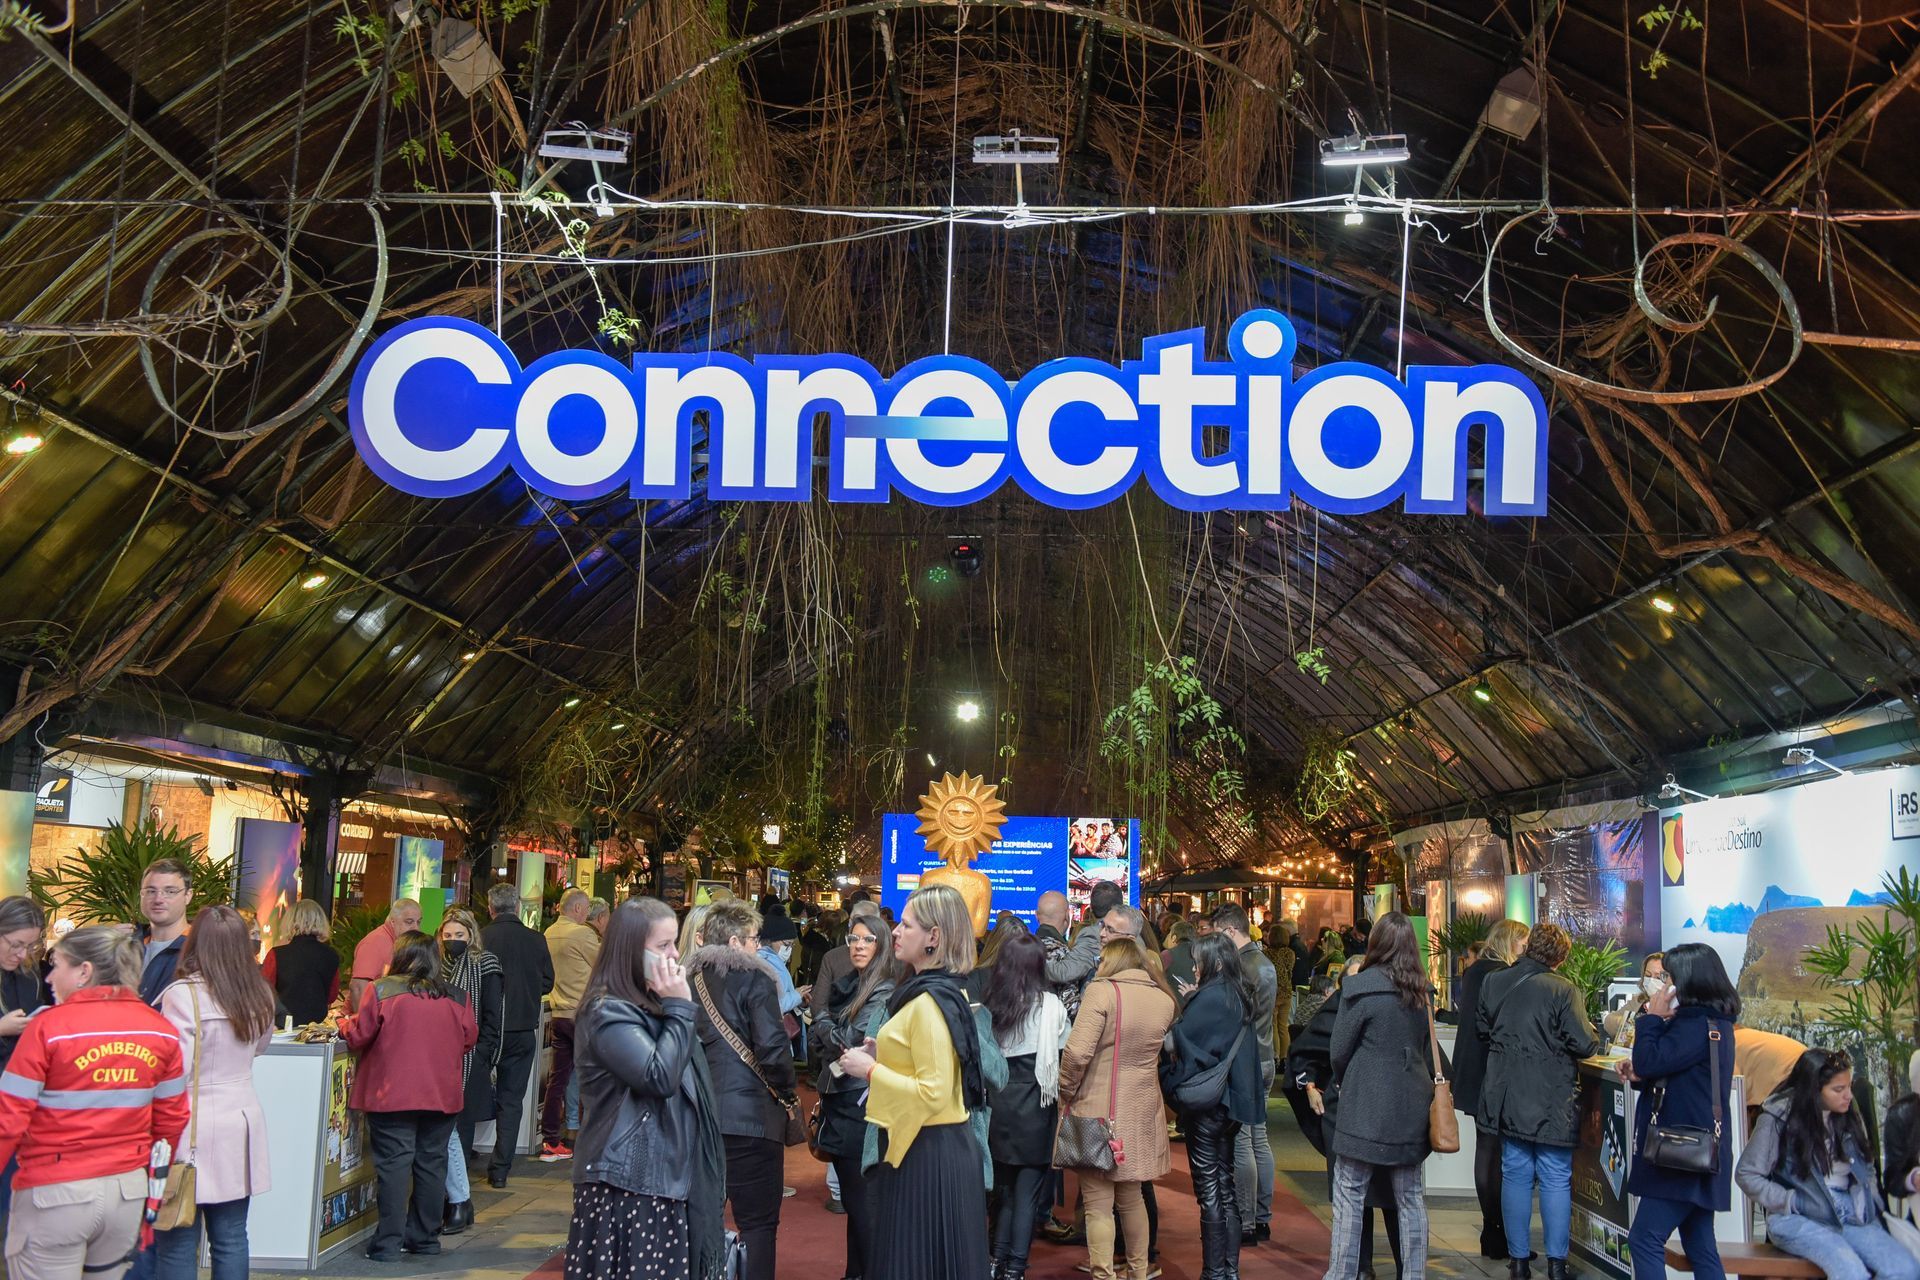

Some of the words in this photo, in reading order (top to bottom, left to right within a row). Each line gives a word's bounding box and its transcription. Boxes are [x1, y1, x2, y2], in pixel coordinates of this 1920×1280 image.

[362, 320, 1537, 504] Connection
[890, 829, 898, 864] Connection
[1003, 840, 1053, 849] EXPERIÊNCIAS
[74, 1041, 158, 1068] BOMBEIRO
[92, 1068, 139, 1083] CIVIL
